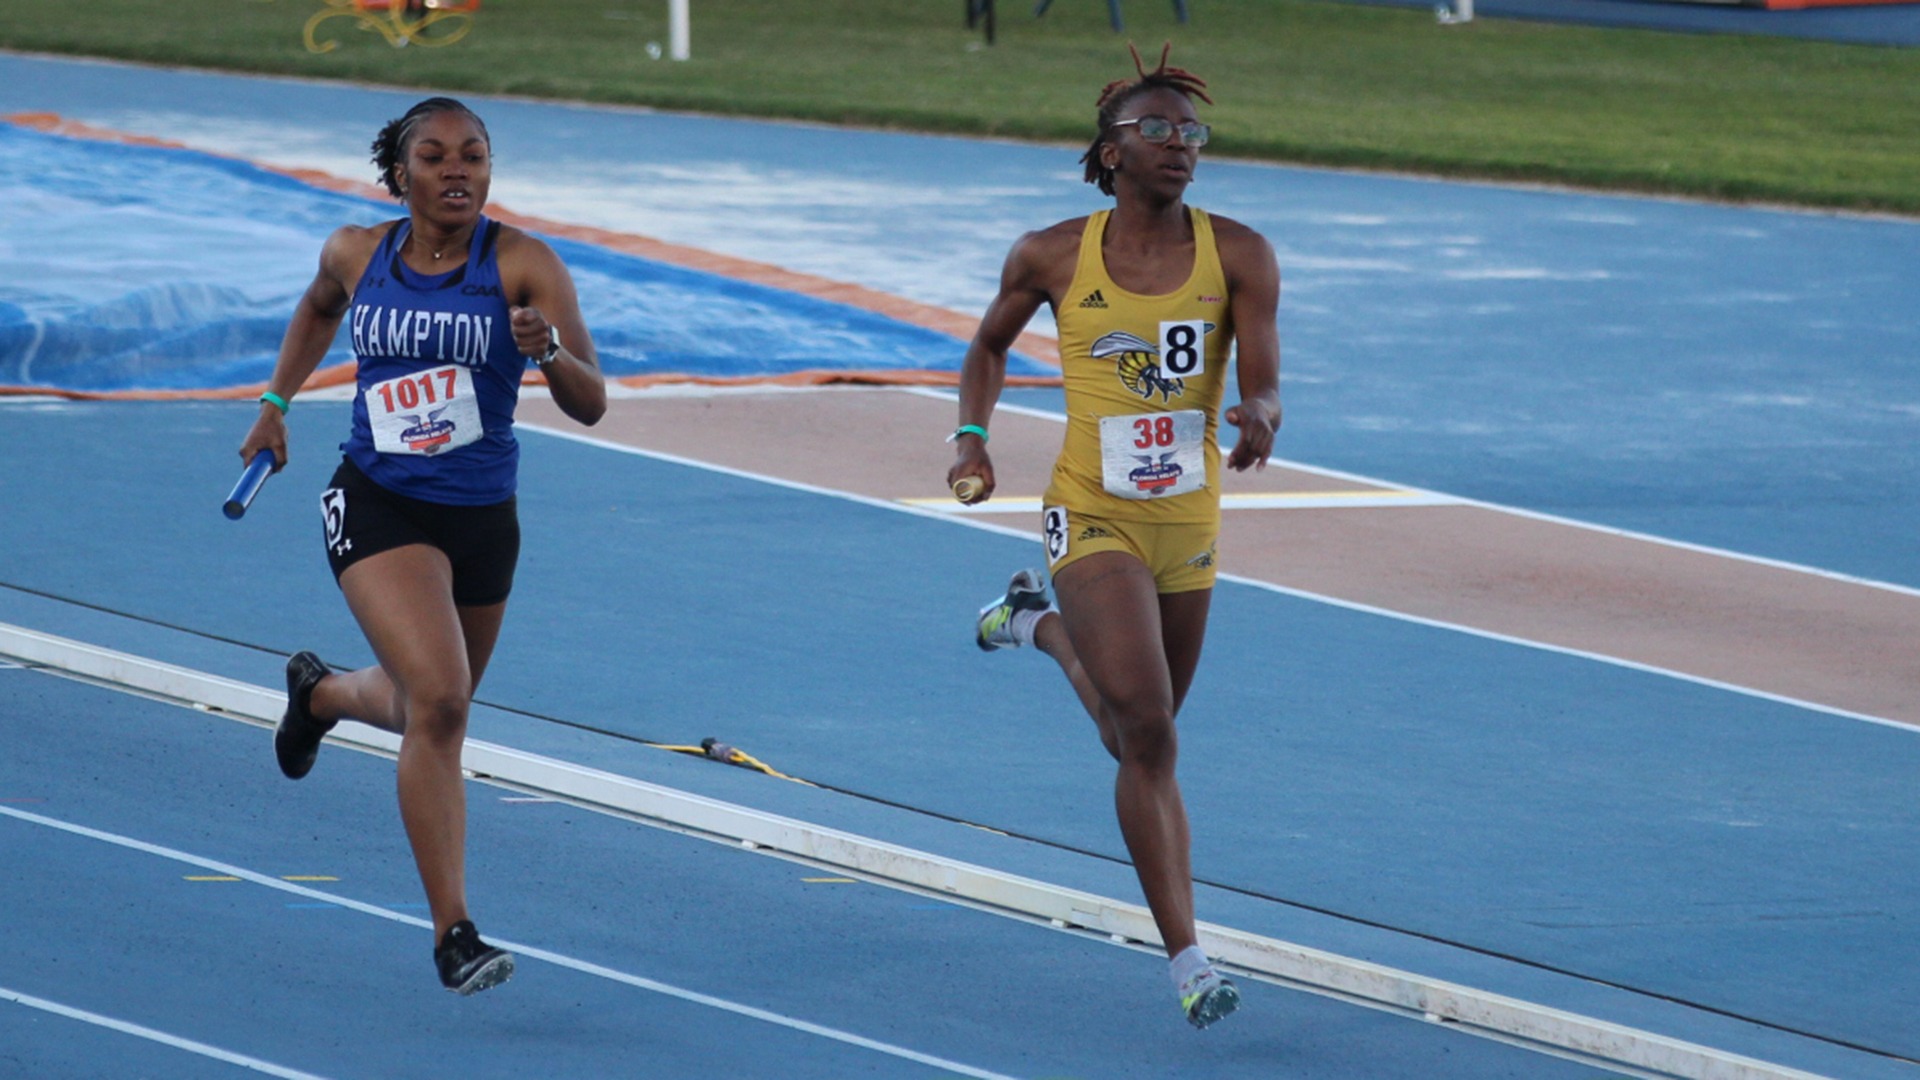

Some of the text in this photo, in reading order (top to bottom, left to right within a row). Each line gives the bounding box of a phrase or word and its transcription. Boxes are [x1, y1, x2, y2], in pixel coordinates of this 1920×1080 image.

[461, 284, 499, 298] CAA
[1079, 300, 1109, 309] adidas
[353, 304, 493, 366] HAMPTON
[1165, 324, 1198, 374] 8
[377, 368, 457, 414] 1017
[1133, 416, 1175, 449] 38
[322, 489, 341, 542] 5
